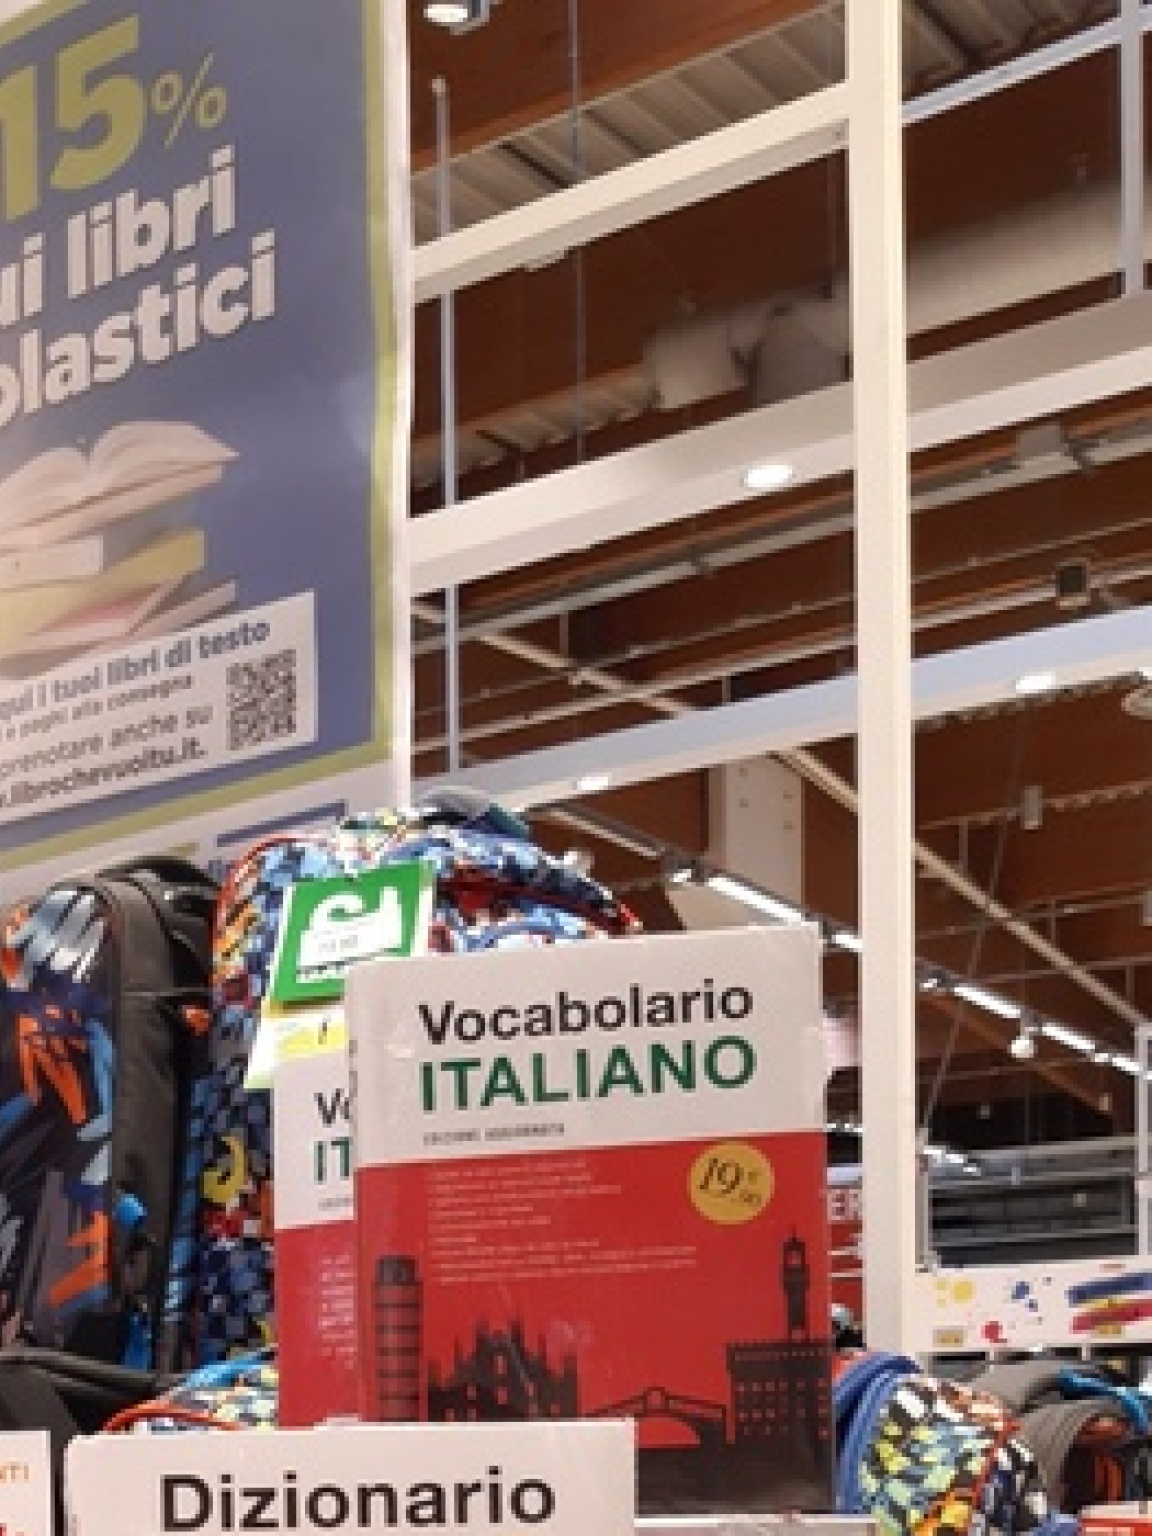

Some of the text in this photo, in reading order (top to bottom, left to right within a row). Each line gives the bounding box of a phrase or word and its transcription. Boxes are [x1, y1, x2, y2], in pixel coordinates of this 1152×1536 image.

[67, 144, 237, 299] libri
[51, 668, 102, 703] tuoi
[105, 654, 159, 694] libri
[165, 641, 193, 672] di
[198, 618, 271, 662] testo
[109, 712, 179, 750] anche
[183, 704, 214, 728] su
[418, 978, 754, 1047] Vocabolario
[419, 1035, 758, 1113] ITALIANO
[159, 1465, 555, 1532] Dizionario
